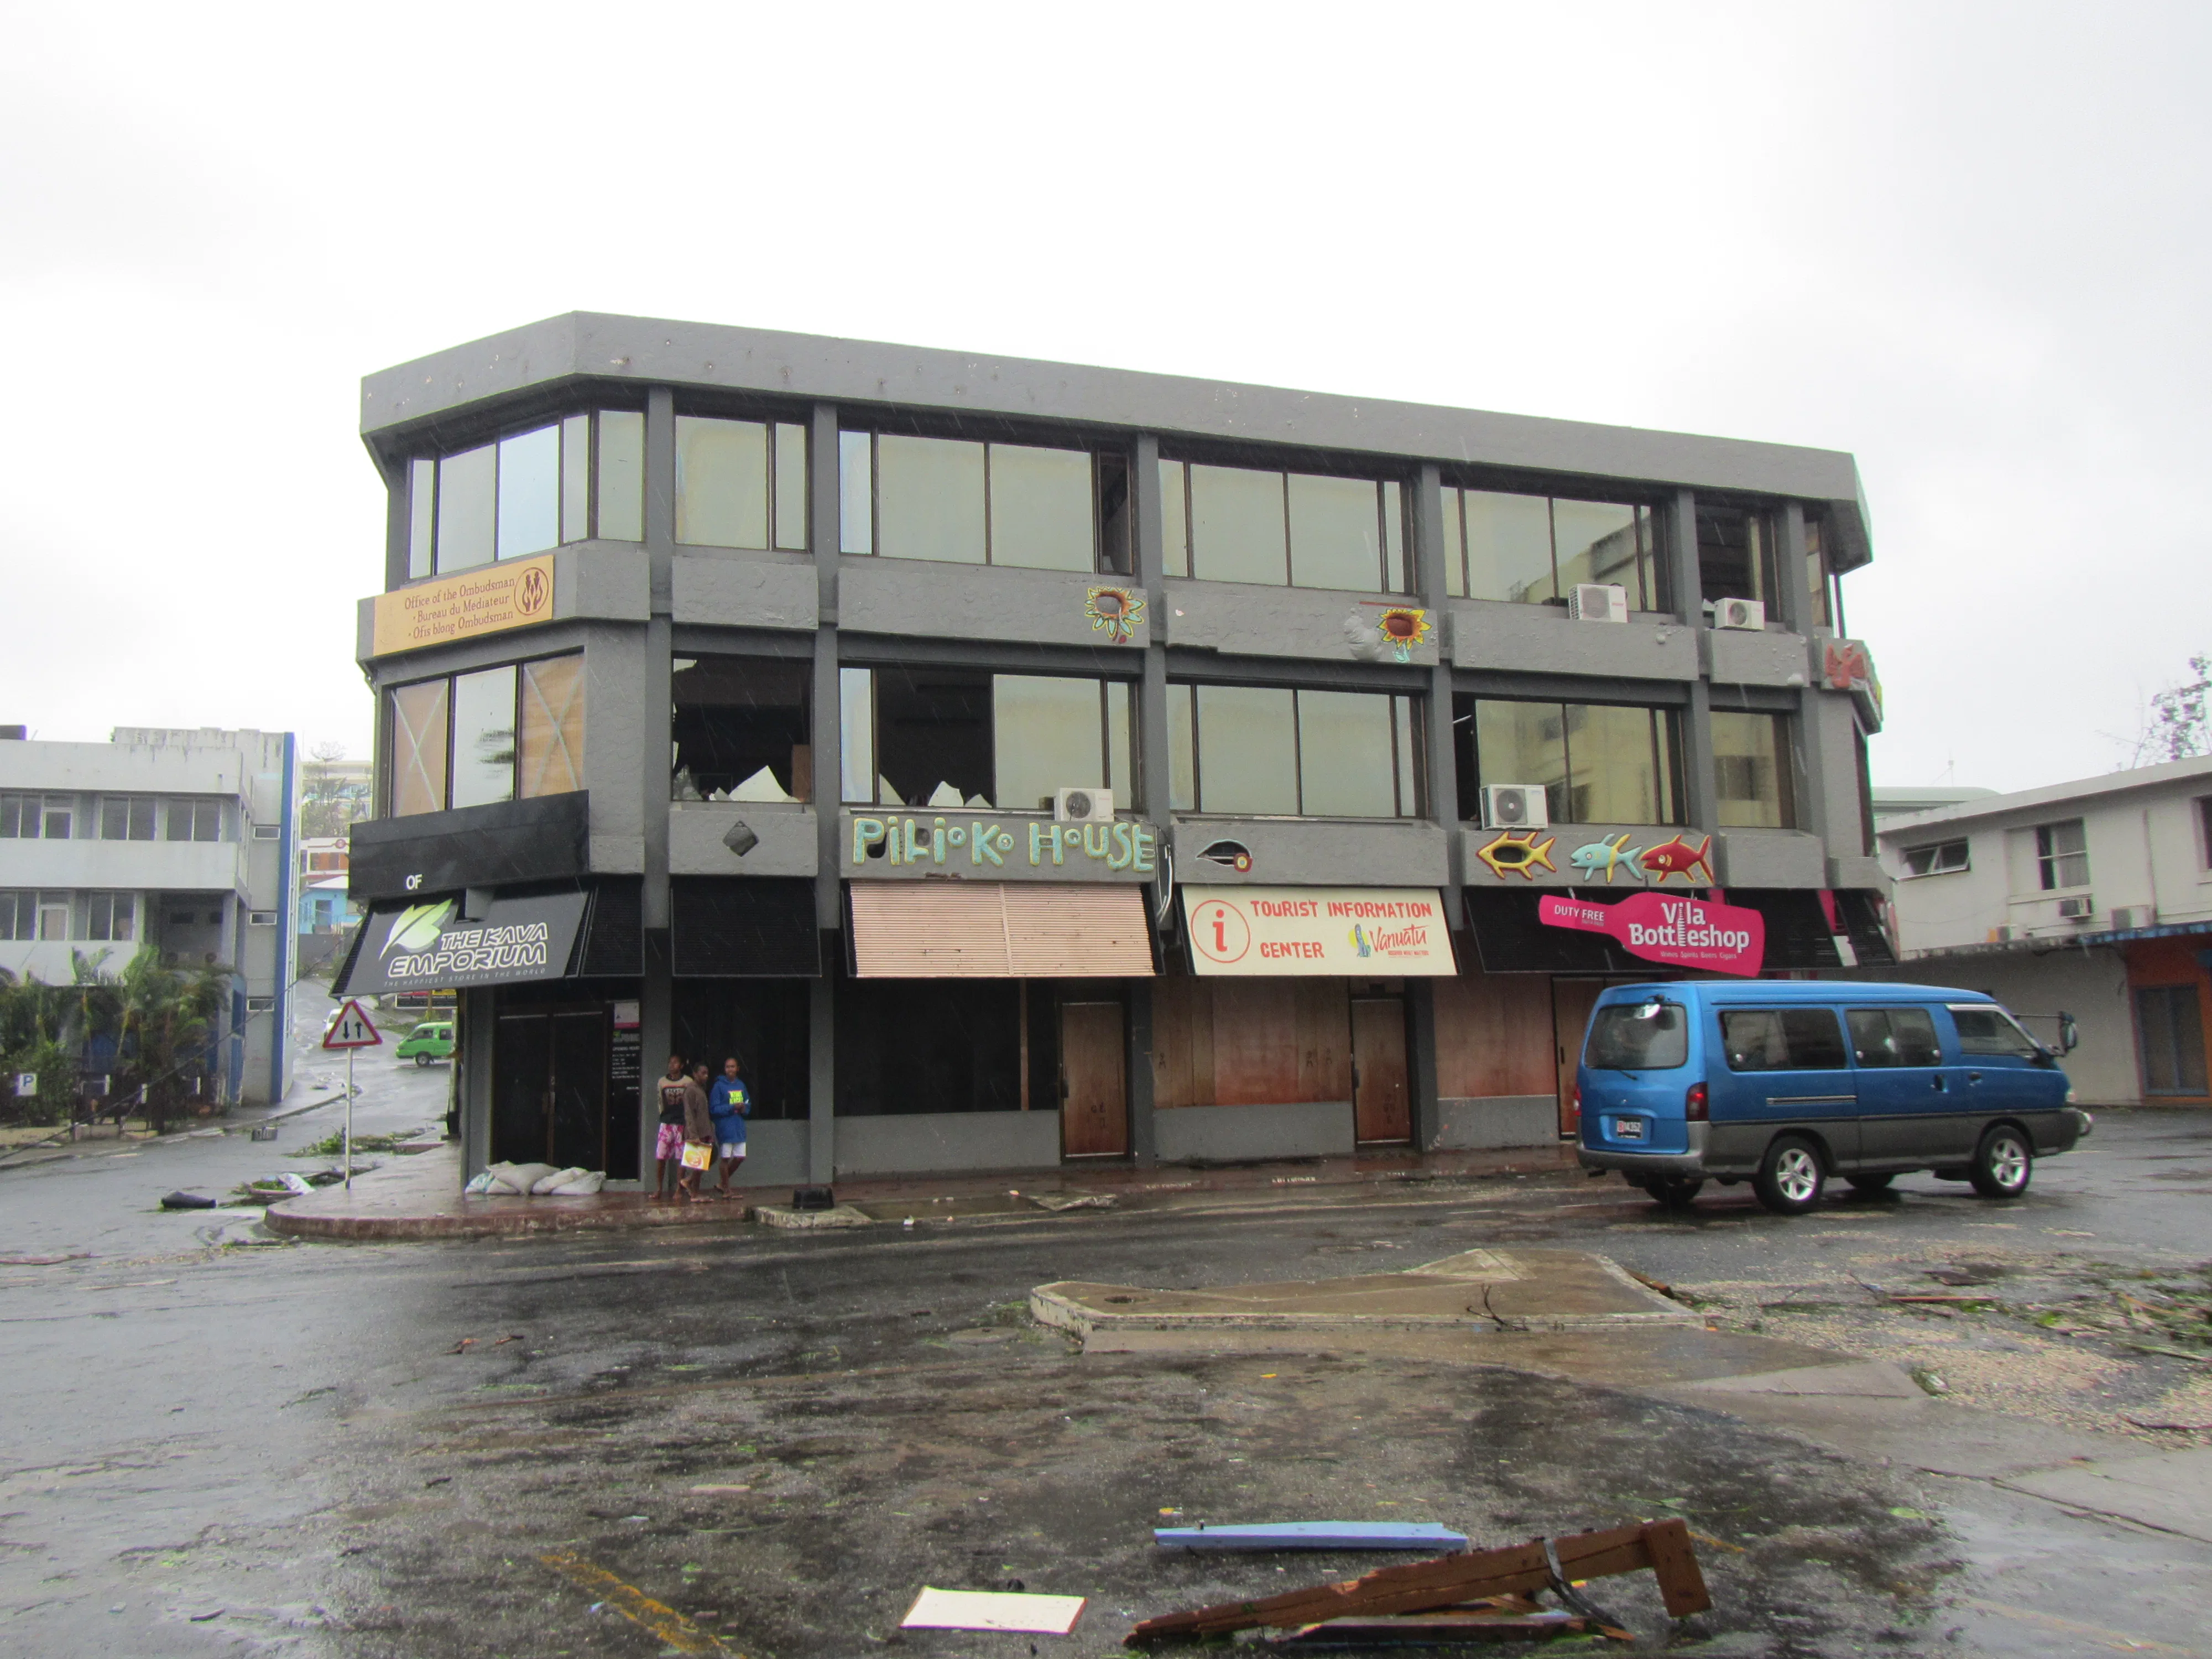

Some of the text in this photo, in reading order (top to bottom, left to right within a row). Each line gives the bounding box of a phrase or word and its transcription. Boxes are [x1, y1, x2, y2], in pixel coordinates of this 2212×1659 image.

[405, 578, 515, 609] Office of the Ombudsman
[417, 594, 509, 623] Bureau du Médiateur
[413, 610, 513, 639] Ofis blong Ombudsman
[406, 874, 422, 890] OF
[1250, 900, 1432, 918] TOURIST INFORMATION
[1554, 905, 1604, 921] DUTY FREE
[1661, 901, 1705, 926] Vila
[441, 922, 548, 951] THE KAVA
[1369, 924, 1430, 952] Vanuatu
[1629, 923, 1750, 952] Bottleshop
[388, 942, 547, 978] EMPORIUM
[1260, 942, 1324, 958] CENTER
[403, 977, 444, 986] HAPPIEST
[448, 973, 475, 982] STORE
[515, 968, 545, 977] WORLD
[23, 1075, 34, 1087] P
